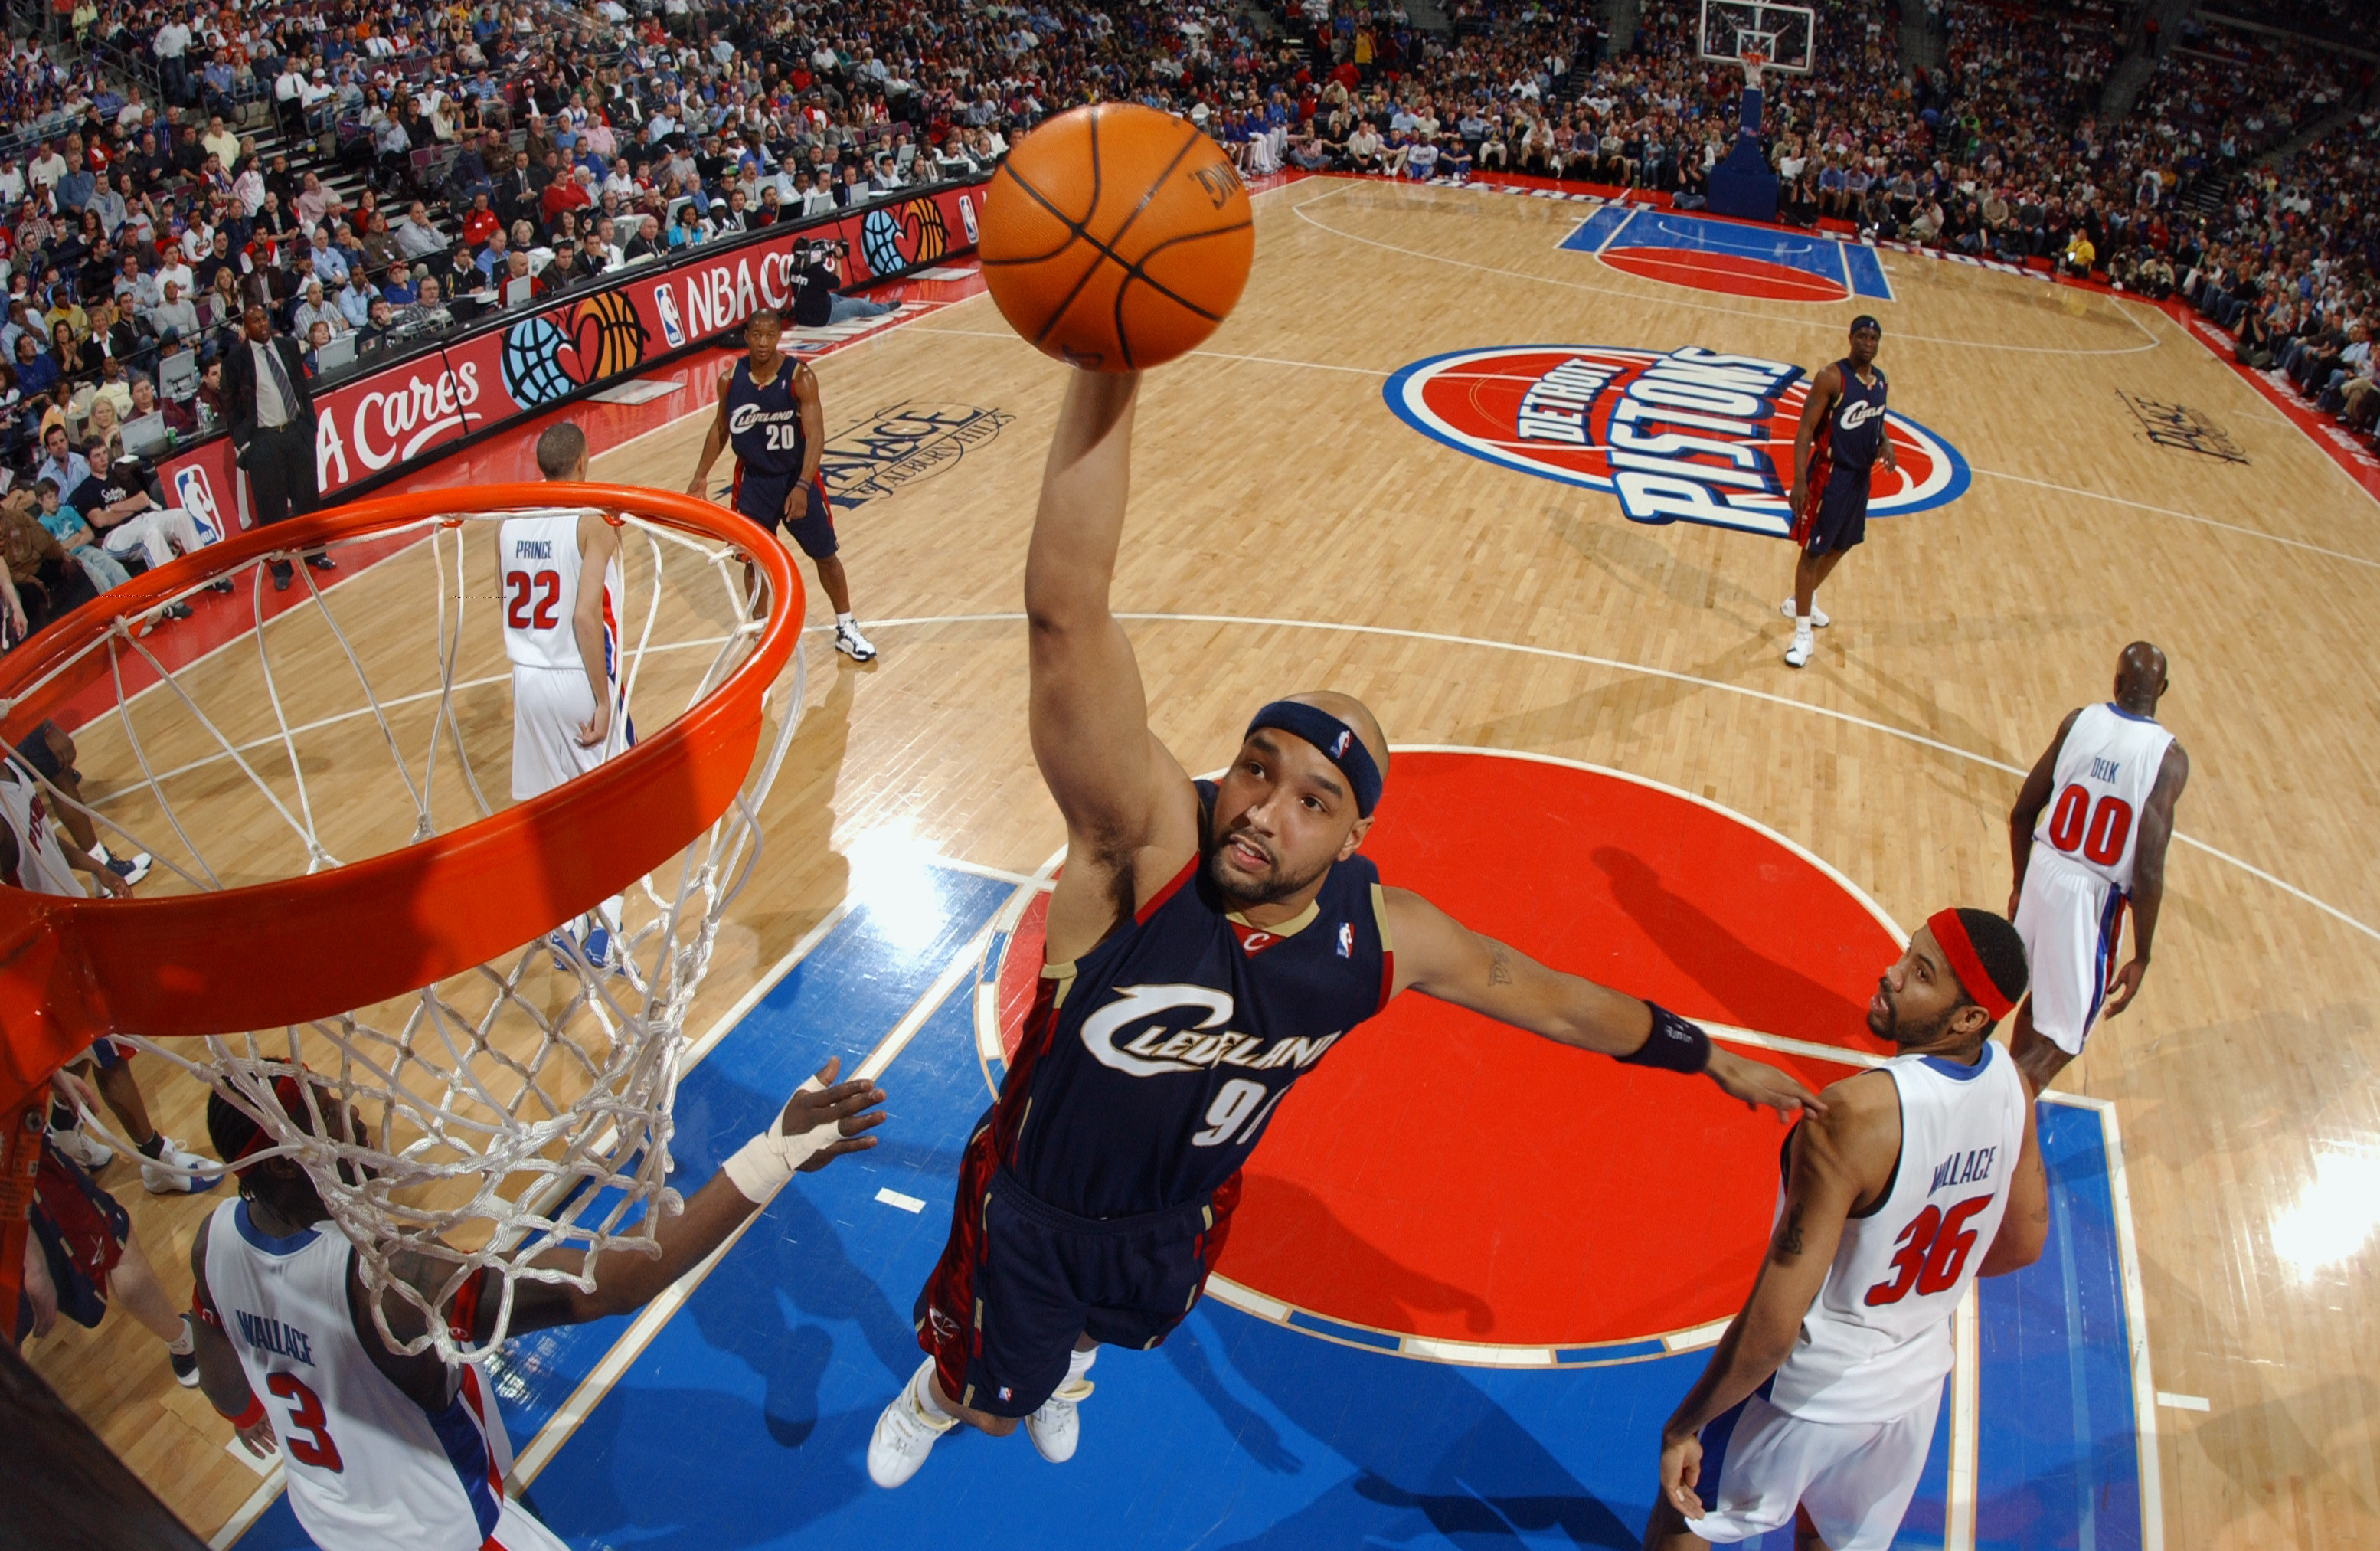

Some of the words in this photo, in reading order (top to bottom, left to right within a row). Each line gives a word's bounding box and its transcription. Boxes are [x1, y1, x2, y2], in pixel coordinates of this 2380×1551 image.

[687, 257, 758, 339] NBA
[353, 361, 480, 470] Cares
[729, 403, 794, 434] CLEVELAND
[766, 424, 795, 450] 20
[1517, 358, 1629, 447] DETROIT
[883, 440, 957, 487] AUBURN
[1607, 345, 1807, 539] PISTONS
[515, 540, 551, 560] PRINCE
[506, 569, 561, 630] 22
[2090, 758, 2120, 784] DELK
[2048, 783, 2133, 867] 00
[1192, 1078, 1300, 1147] 9
[1864, 1192, 1996, 1307] 36
[236, 1309, 315, 1367] WALLACE
[266, 1371, 345, 1474] 3
